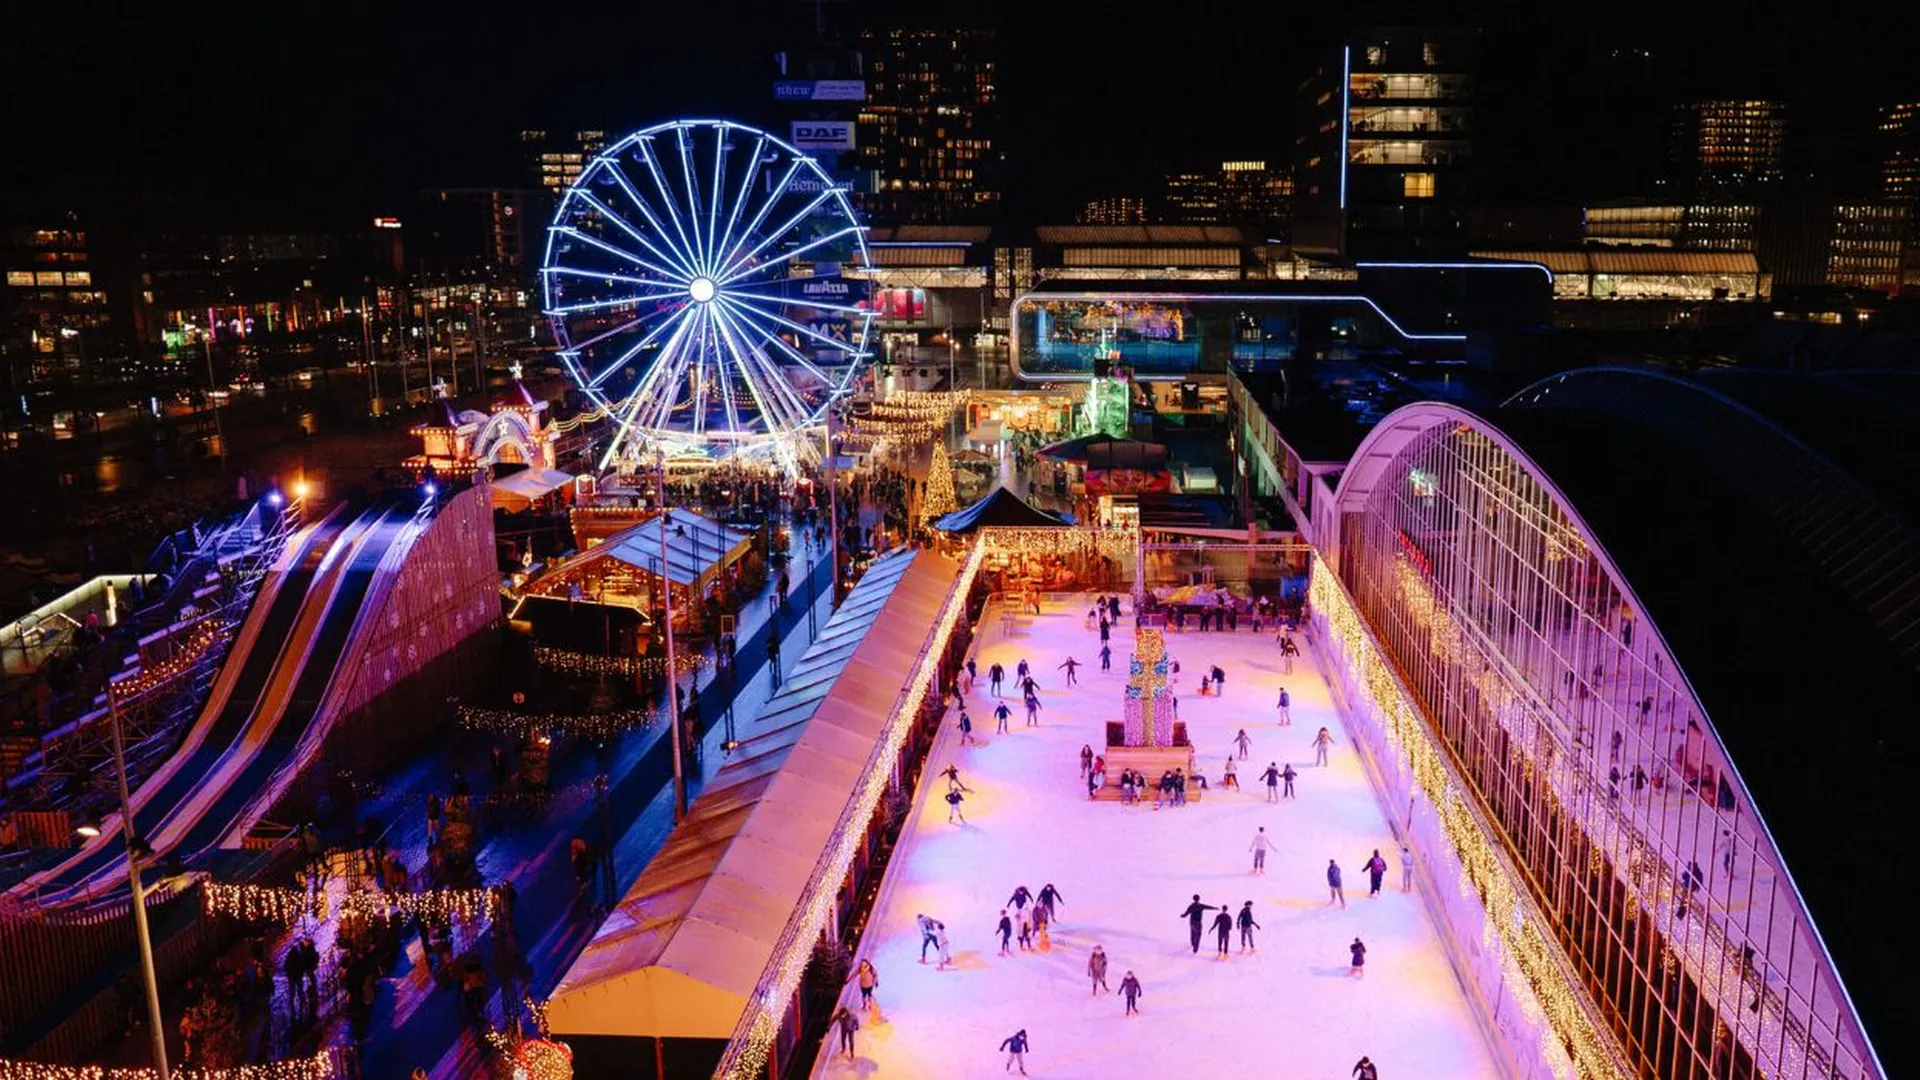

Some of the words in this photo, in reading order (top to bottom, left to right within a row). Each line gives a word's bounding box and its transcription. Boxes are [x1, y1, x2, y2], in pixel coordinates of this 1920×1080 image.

[796, 128, 847, 138] DAF
[788, 179, 854, 192] Heineen
[803, 280, 849, 294] LAVAZZA
